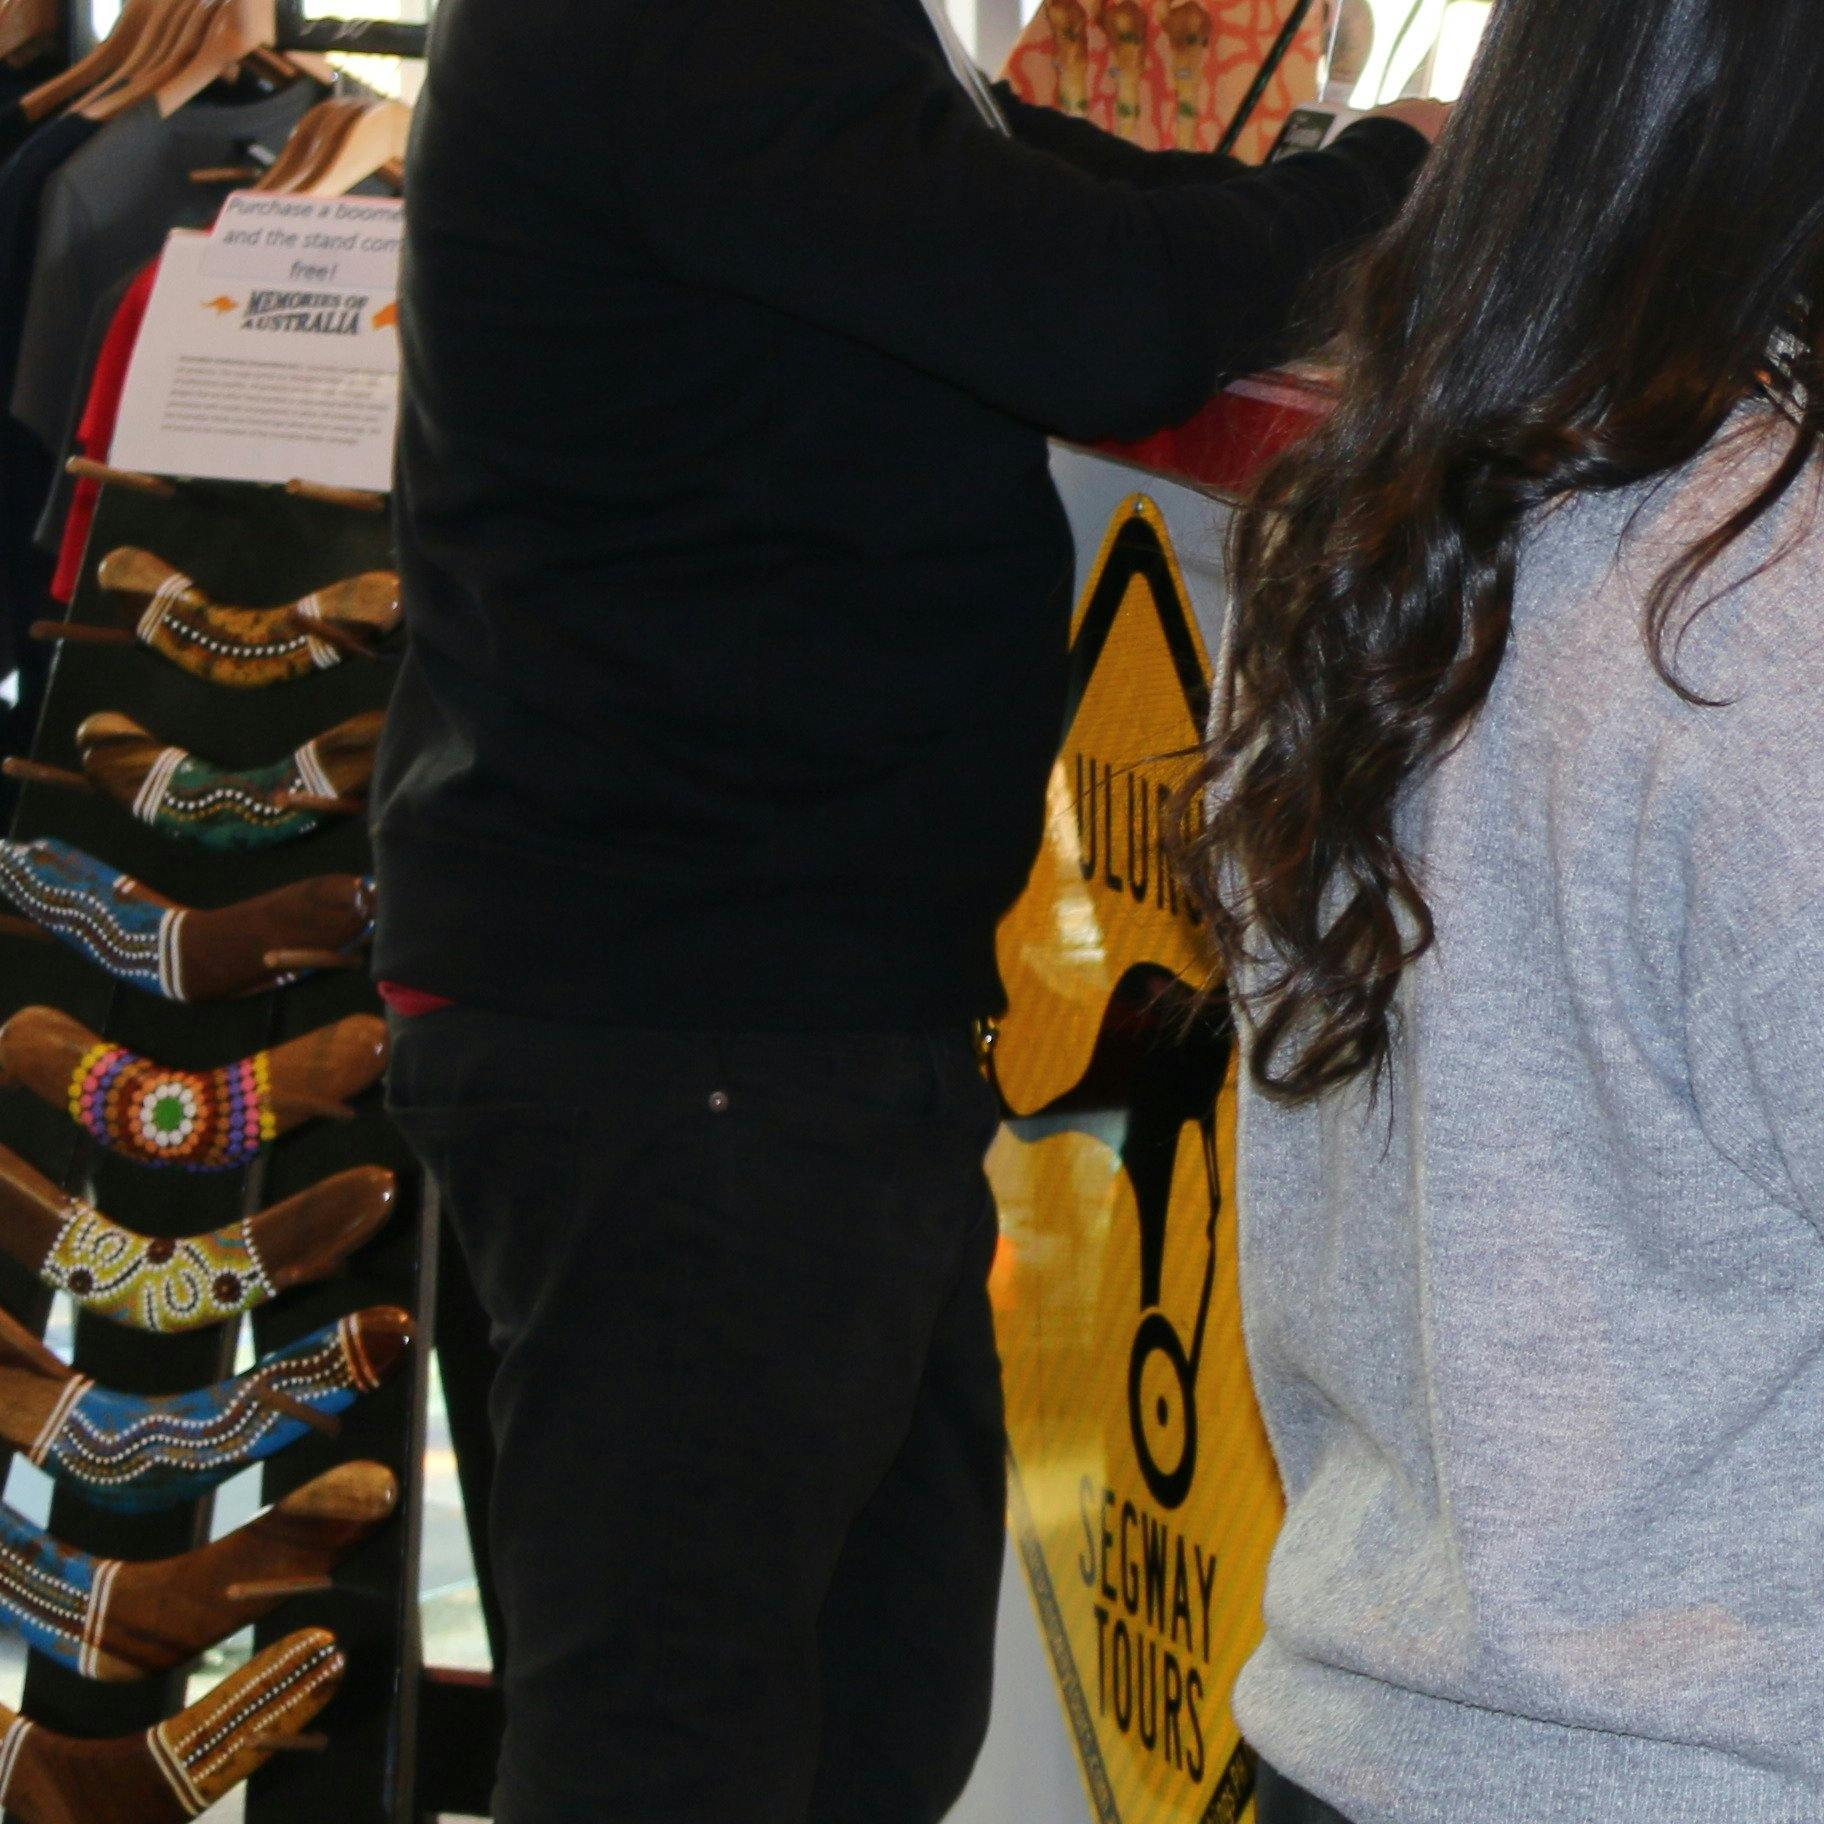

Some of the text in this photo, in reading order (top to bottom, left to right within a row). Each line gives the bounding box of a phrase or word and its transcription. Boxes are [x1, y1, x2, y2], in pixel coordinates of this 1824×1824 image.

[229, 197, 313, 217] Purchase
[224, 229, 262, 245] and
[265, 228, 298, 247] the
[303, 233, 357, 250] stand
[289, 261, 338, 281] free!
[245, 289, 342, 318] MEMORIES
[241, 311, 359, 335] AUSTRALIA
[1078, 1475, 1217, 1665] SEGWAY
[1094, 1603, 1205, 1784] TOURS
